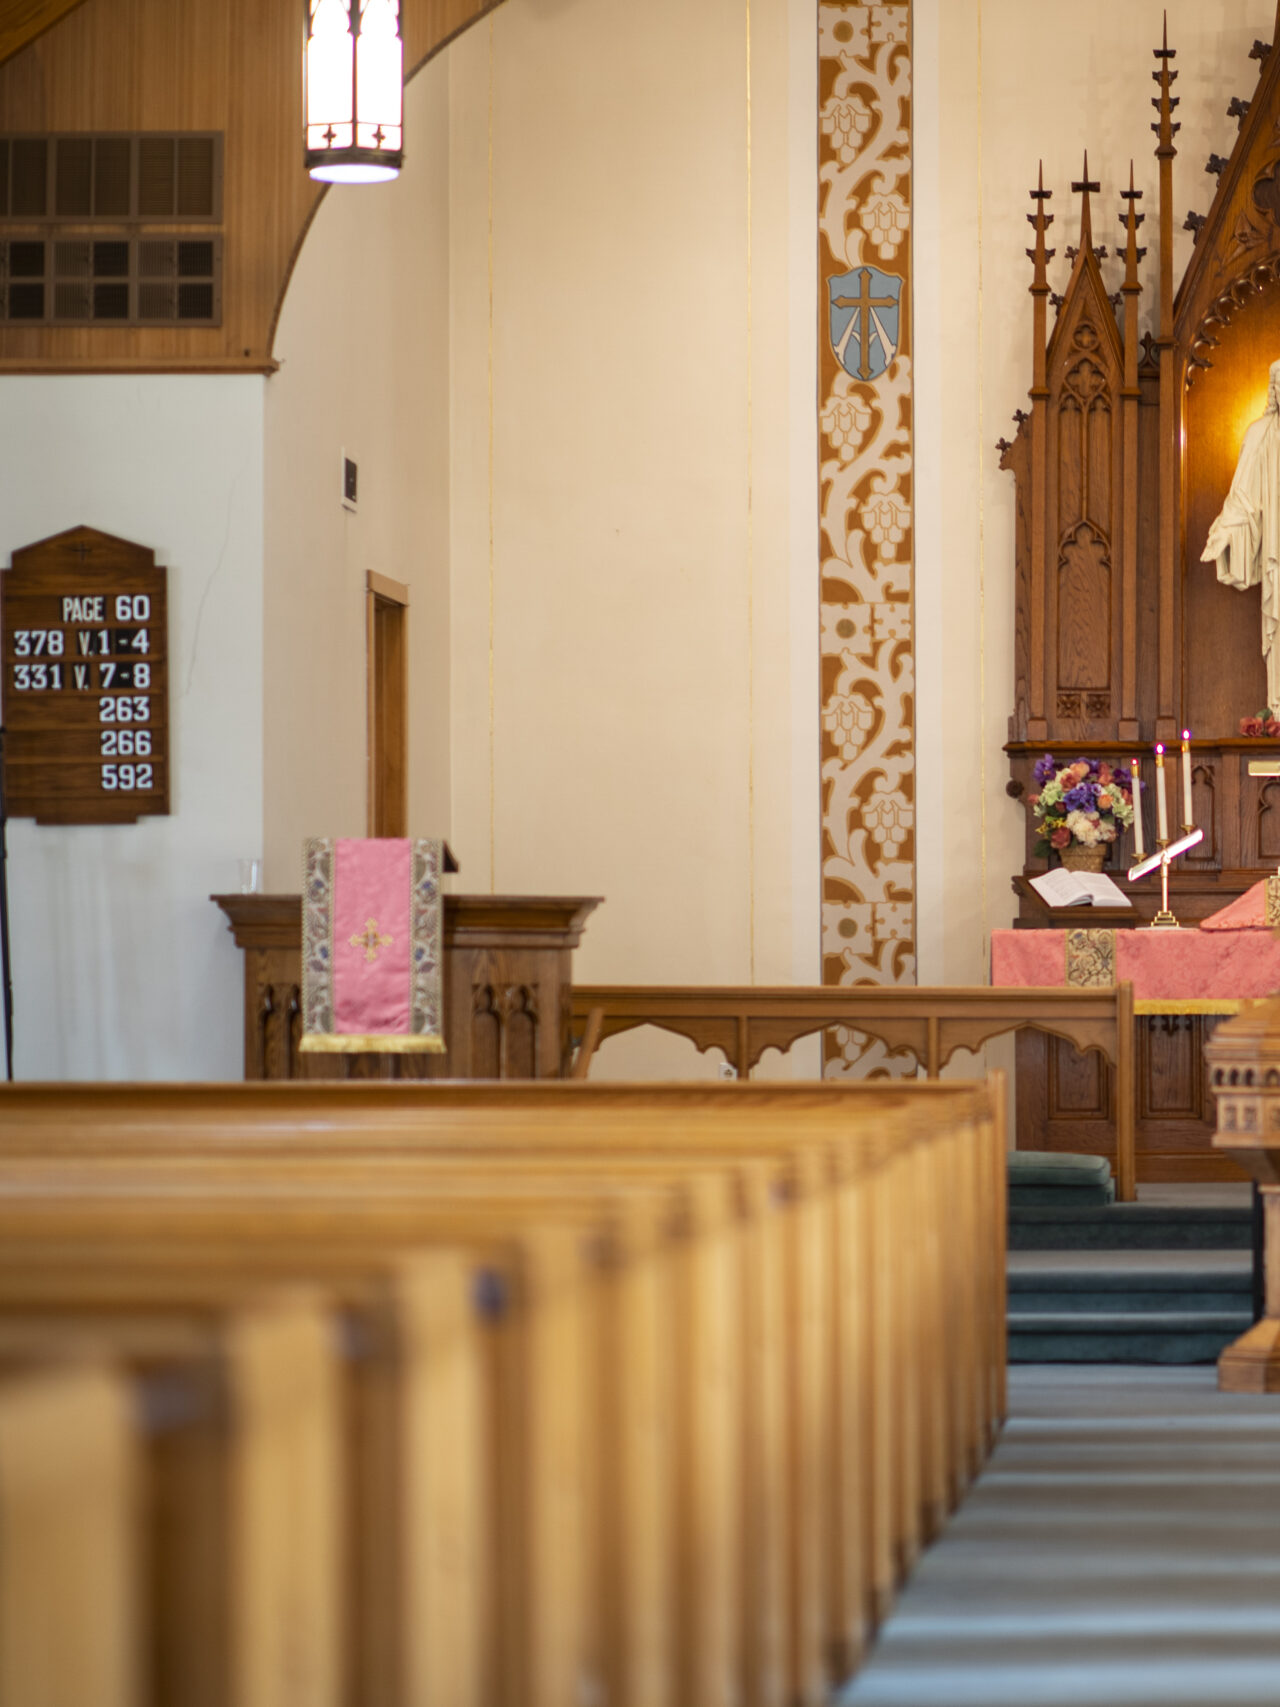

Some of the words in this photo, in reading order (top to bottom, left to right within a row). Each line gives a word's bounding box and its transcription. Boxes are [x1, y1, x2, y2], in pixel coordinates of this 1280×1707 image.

[62, 596, 104, 622] PAGE
[115, 595, 150, 621] 60
[14, 630, 64, 656] 378
[14, 664, 62, 690] 331
[99, 696, 150, 722] 263
[101, 730, 152, 756] 266
[101, 764, 153, 790] 592
